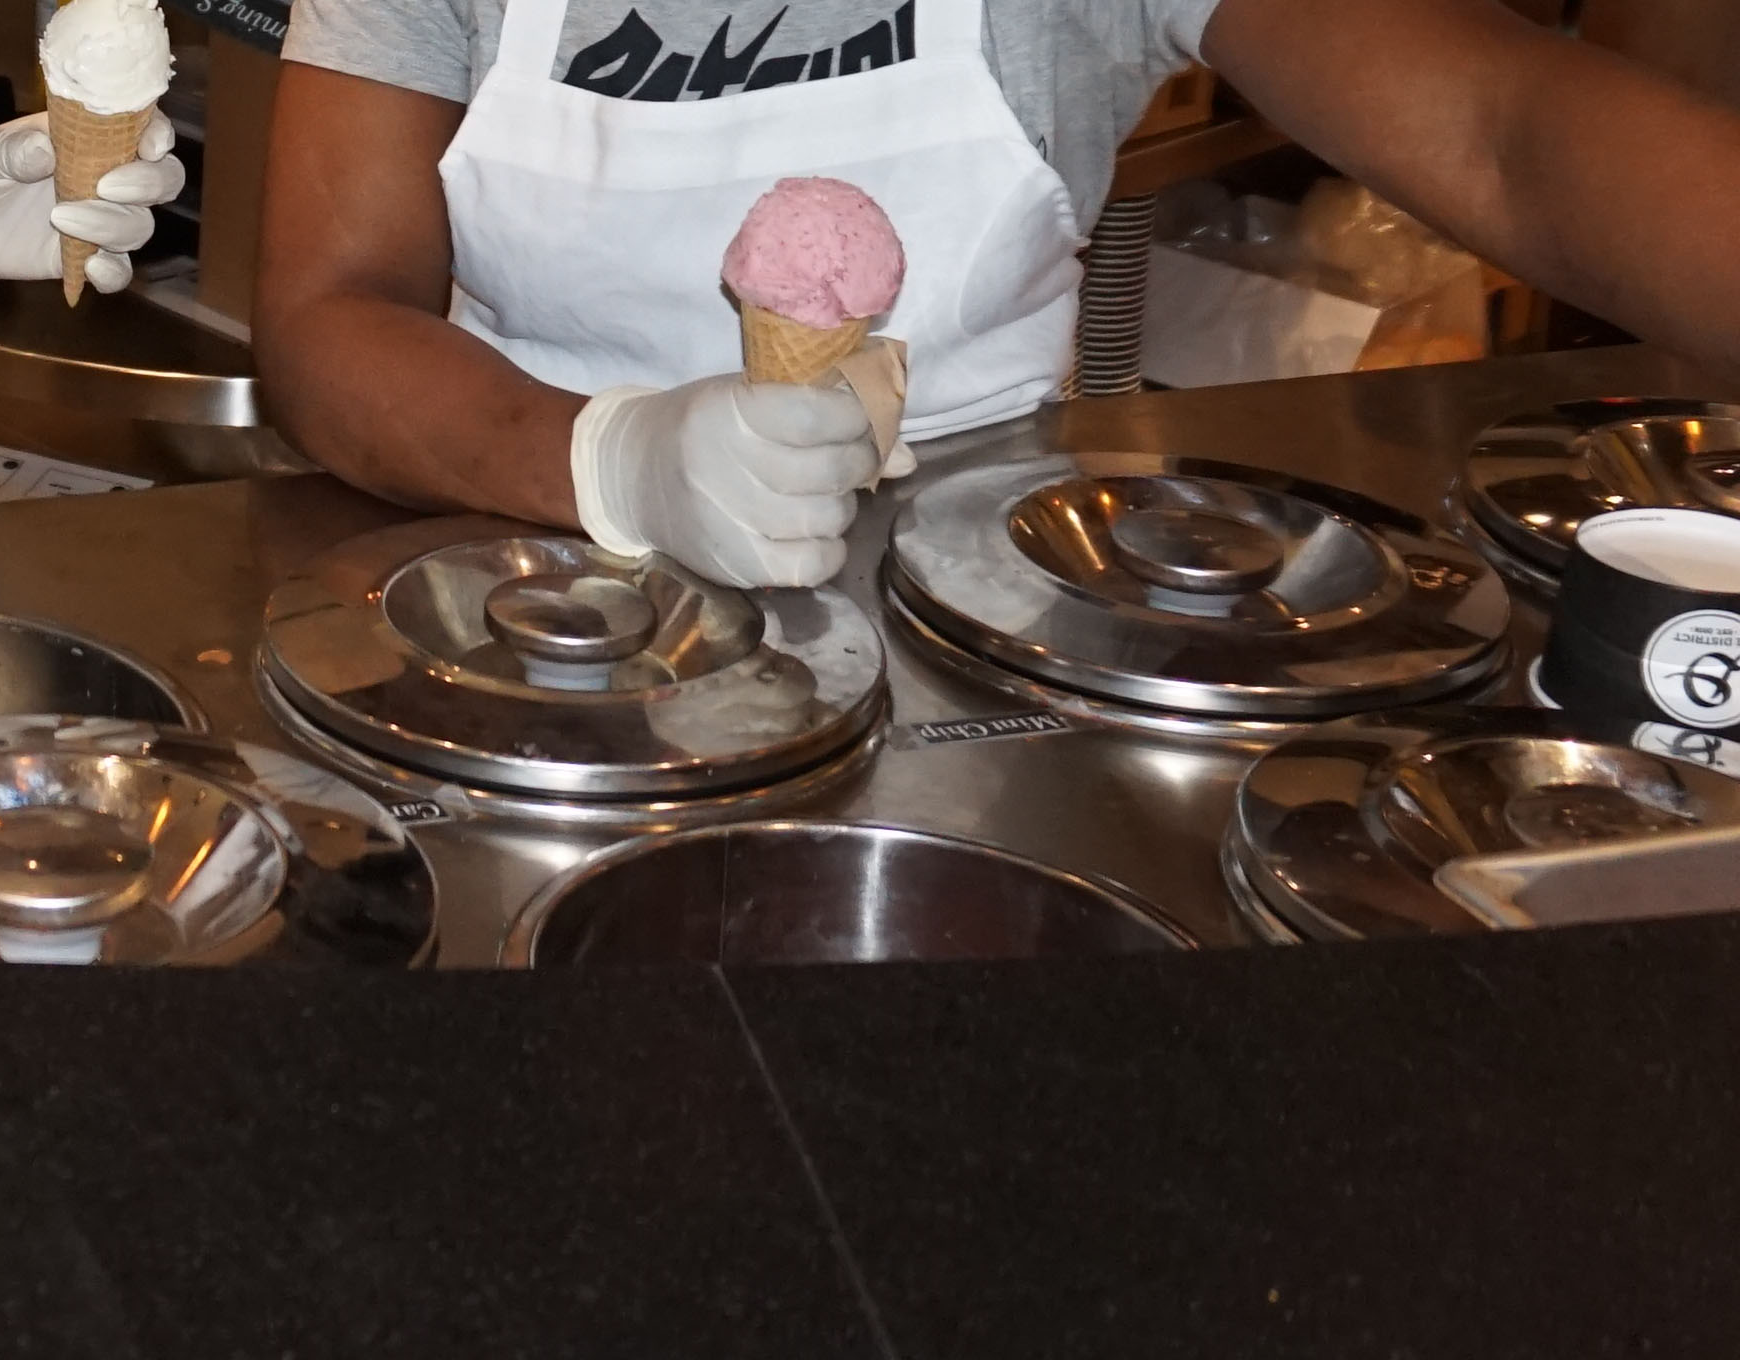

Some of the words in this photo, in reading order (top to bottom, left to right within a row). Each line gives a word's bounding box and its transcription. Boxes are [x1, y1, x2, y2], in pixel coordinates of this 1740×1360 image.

[1673, 632, 1733, 648] DISTRICT
[920, 722, 988, 739] Chip
[989, 714, 1061, 731] Mint
